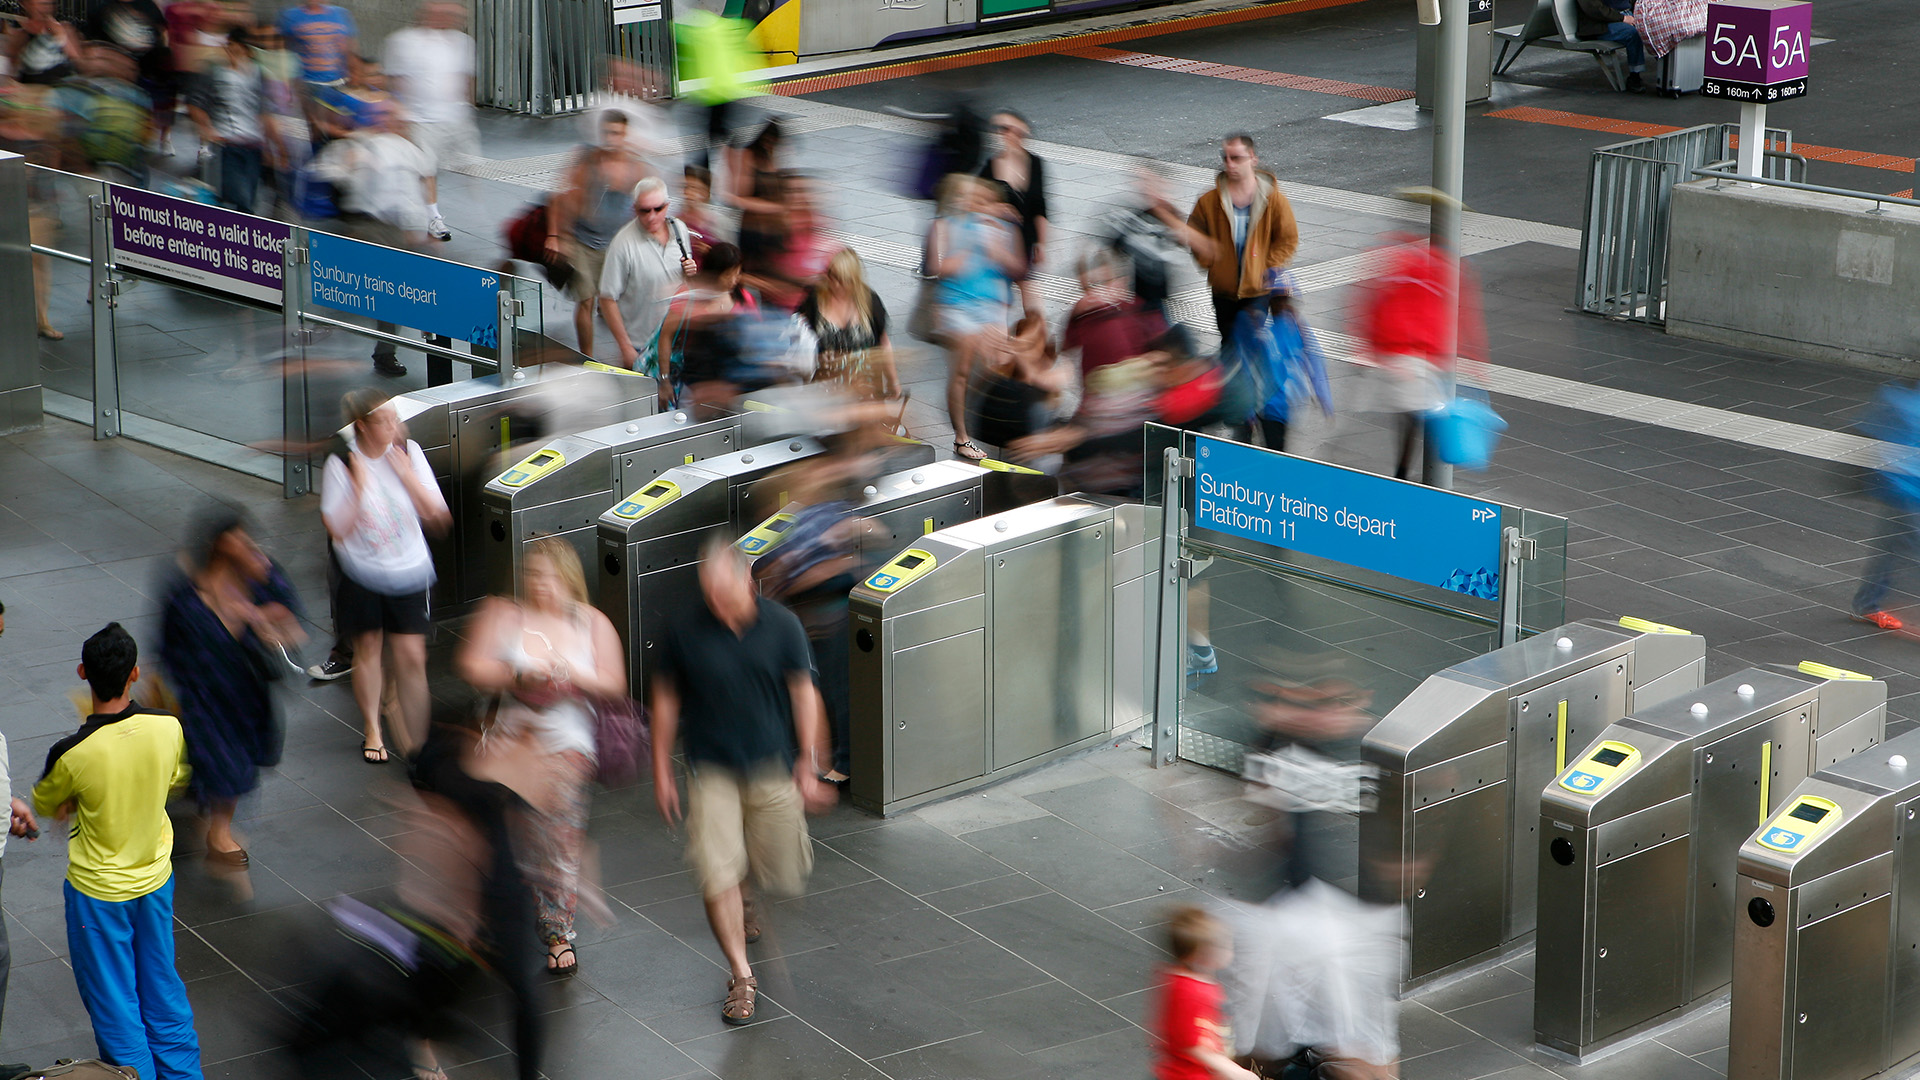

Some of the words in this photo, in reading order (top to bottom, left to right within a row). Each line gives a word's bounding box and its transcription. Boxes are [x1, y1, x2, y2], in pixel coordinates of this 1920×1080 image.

[1711, 22, 1762, 69] 5A
[1771, 25, 1805, 69] 5A
[1706, 82, 1720, 95] 5B
[1726, 87, 1750, 98] 160m
[1767, 88, 1778, 100] 5B
[1780, 87, 1797, 97] 160m
[112, 195, 135, 218] You
[139, 206, 171, 227] must
[174, 210, 204, 235] have
[208, 222, 216, 238] a
[219, 224, 249, 246] valid
[252, 230, 286, 254] ticke
[124, 222, 165, 250] before
[168, 238, 221, 268] entering
[223, 248, 249, 271] this
[252, 260, 282, 280] area
[313, 260, 360, 291] Sunbury
[364, 273, 395, 296] trains
[398, 282, 438, 306] depart
[313, 281, 361, 308] Platform
[364, 295, 376, 311] 11
[1200, 473, 1275, 513] Sunbury
[1280, 492, 1328, 523] trains
[1334, 506, 1396, 539] depart
[1200, 499, 1272, 536] Platform
[1279, 519, 1296, 541] 11
